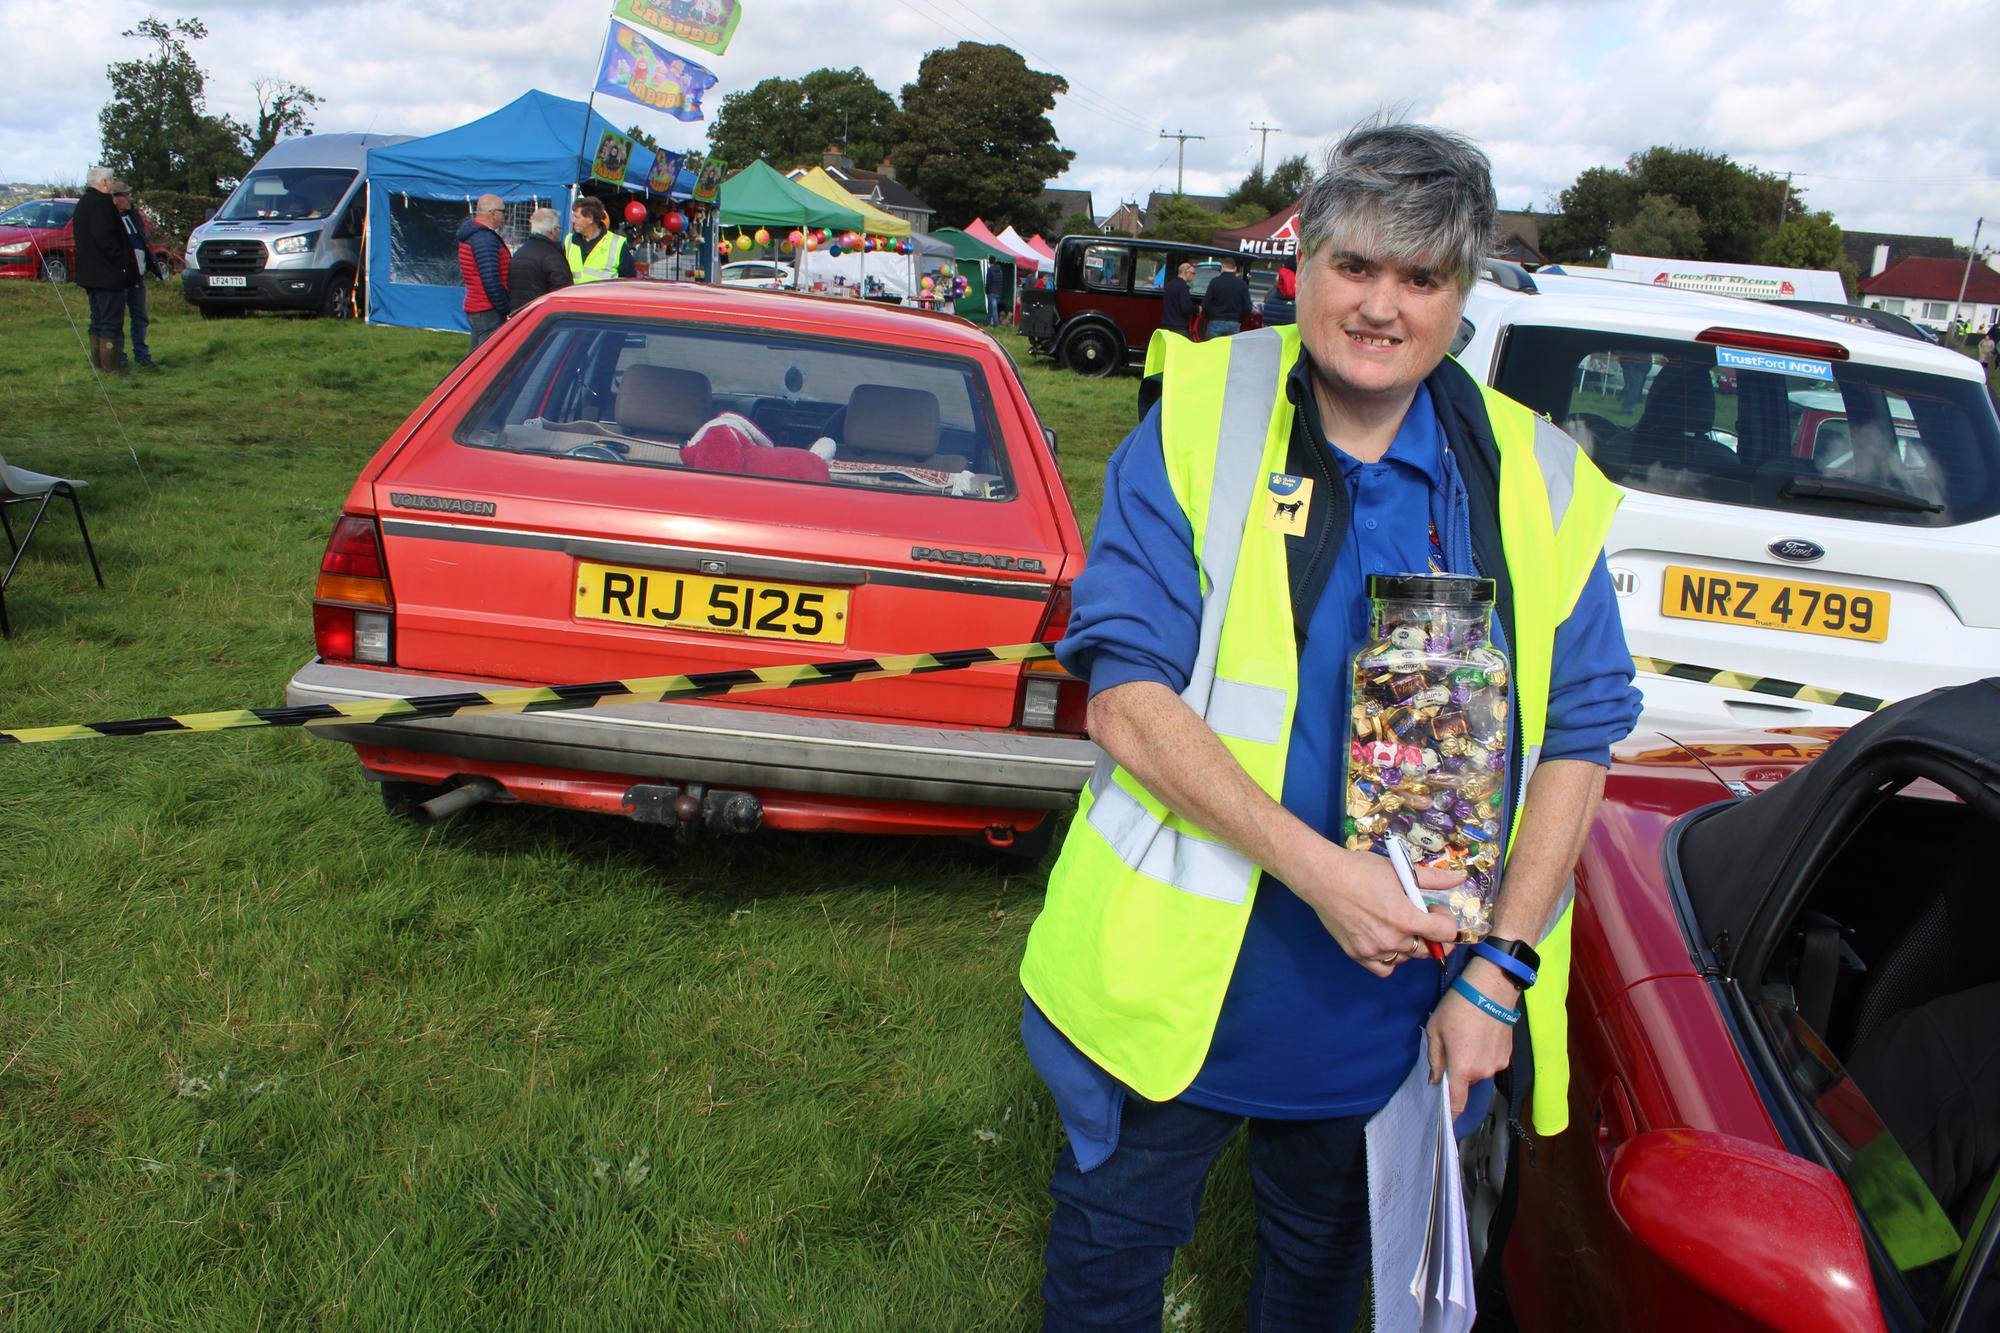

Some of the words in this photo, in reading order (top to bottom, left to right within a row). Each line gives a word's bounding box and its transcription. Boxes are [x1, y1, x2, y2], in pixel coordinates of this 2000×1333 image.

[631, 0, 721, 45] LABUBU
[1240, 238, 1300, 256] MILLE
[1673, 273, 1724, 283] COUNTRY
[1729, 276, 1779, 286] KITCHEN
[1722, 352, 1786, 370] TrustFord
[1789, 361, 1827, 375] NOW
[390, 492, 496, 517] VOLKSWAGEN
[912, 546, 1015, 570] PASSAT
[1781, 541, 1813, 558] Ford
[602, 572, 684, 621] RIJ
[707, 583, 824, 636] 5125
[1680, 574, 1759, 619] NRZ
[1770, 586, 1874, 634] 4799
[1484, 1002, 1502, 1017] Alert
